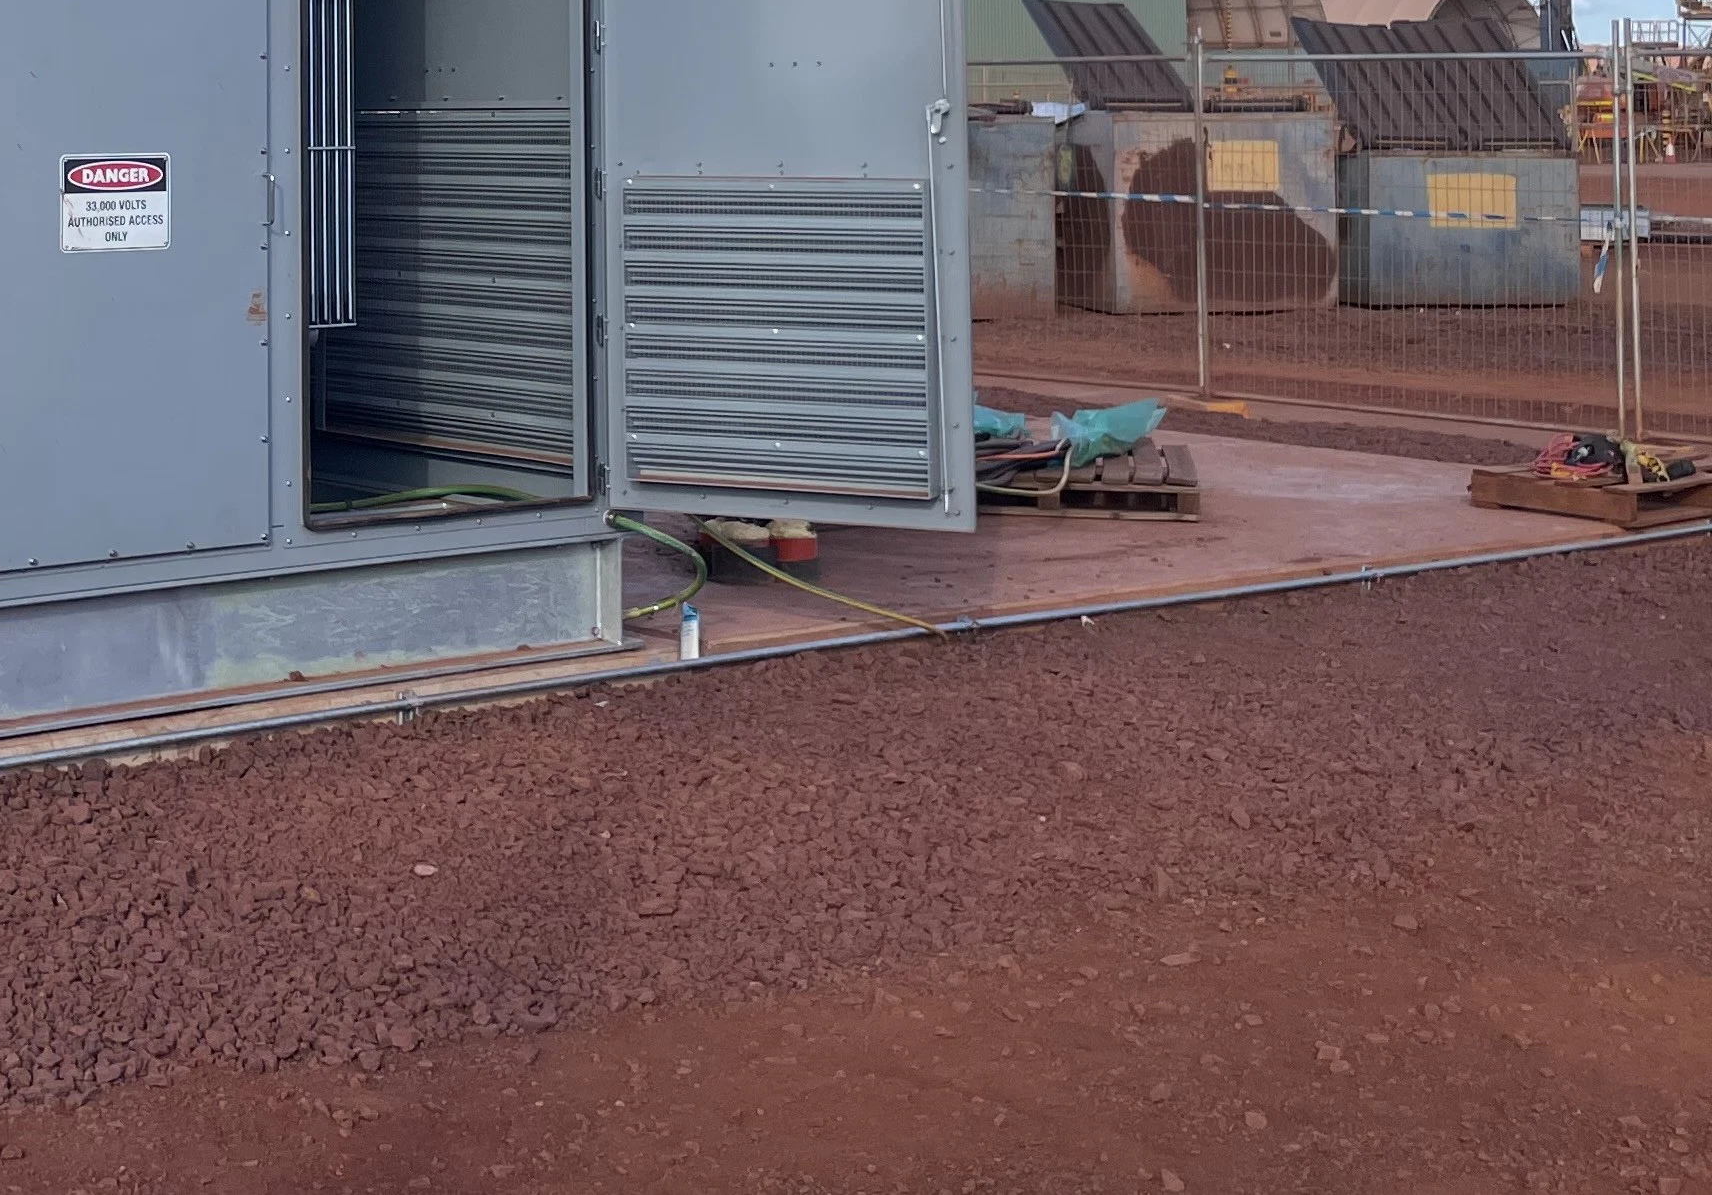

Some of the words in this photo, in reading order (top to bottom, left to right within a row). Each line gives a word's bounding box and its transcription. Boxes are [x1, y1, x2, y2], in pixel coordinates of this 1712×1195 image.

[82, 167, 150, 184] DANGER
[85, 200, 117, 213] 33,000
[118, 199, 147, 210] VOLTS
[67, 216, 126, 228] AUTHORISED
[128, 214, 164, 226] ACCESS
[104, 231, 128, 242] ONLY
